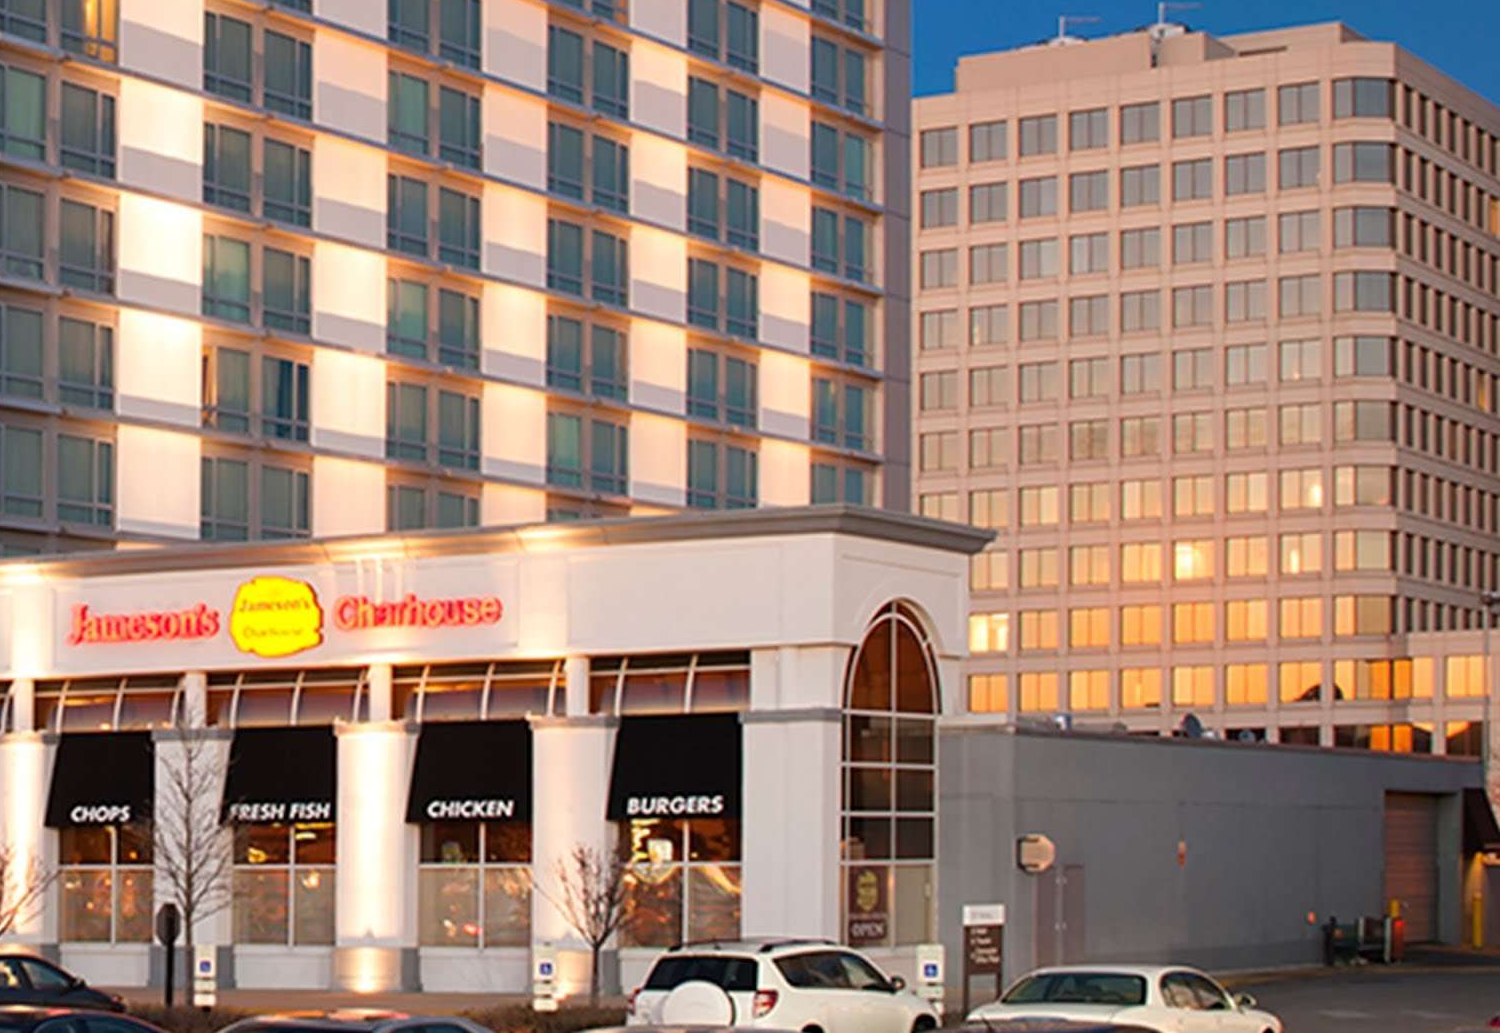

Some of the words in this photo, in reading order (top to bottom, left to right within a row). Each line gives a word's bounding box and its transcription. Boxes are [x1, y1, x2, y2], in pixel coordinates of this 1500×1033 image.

[65, 603, 220, 646] Jameson's
[334, 592, 503, 630] Charhouse
[70, 805, 130, 823] CHOPS
[229, 804, 285, 821] FRESH
[289, 802, 331, 820] FISH
[426, 799, 514, 818] CHICKEN
[626, 795, 724, 815] BURGERS
